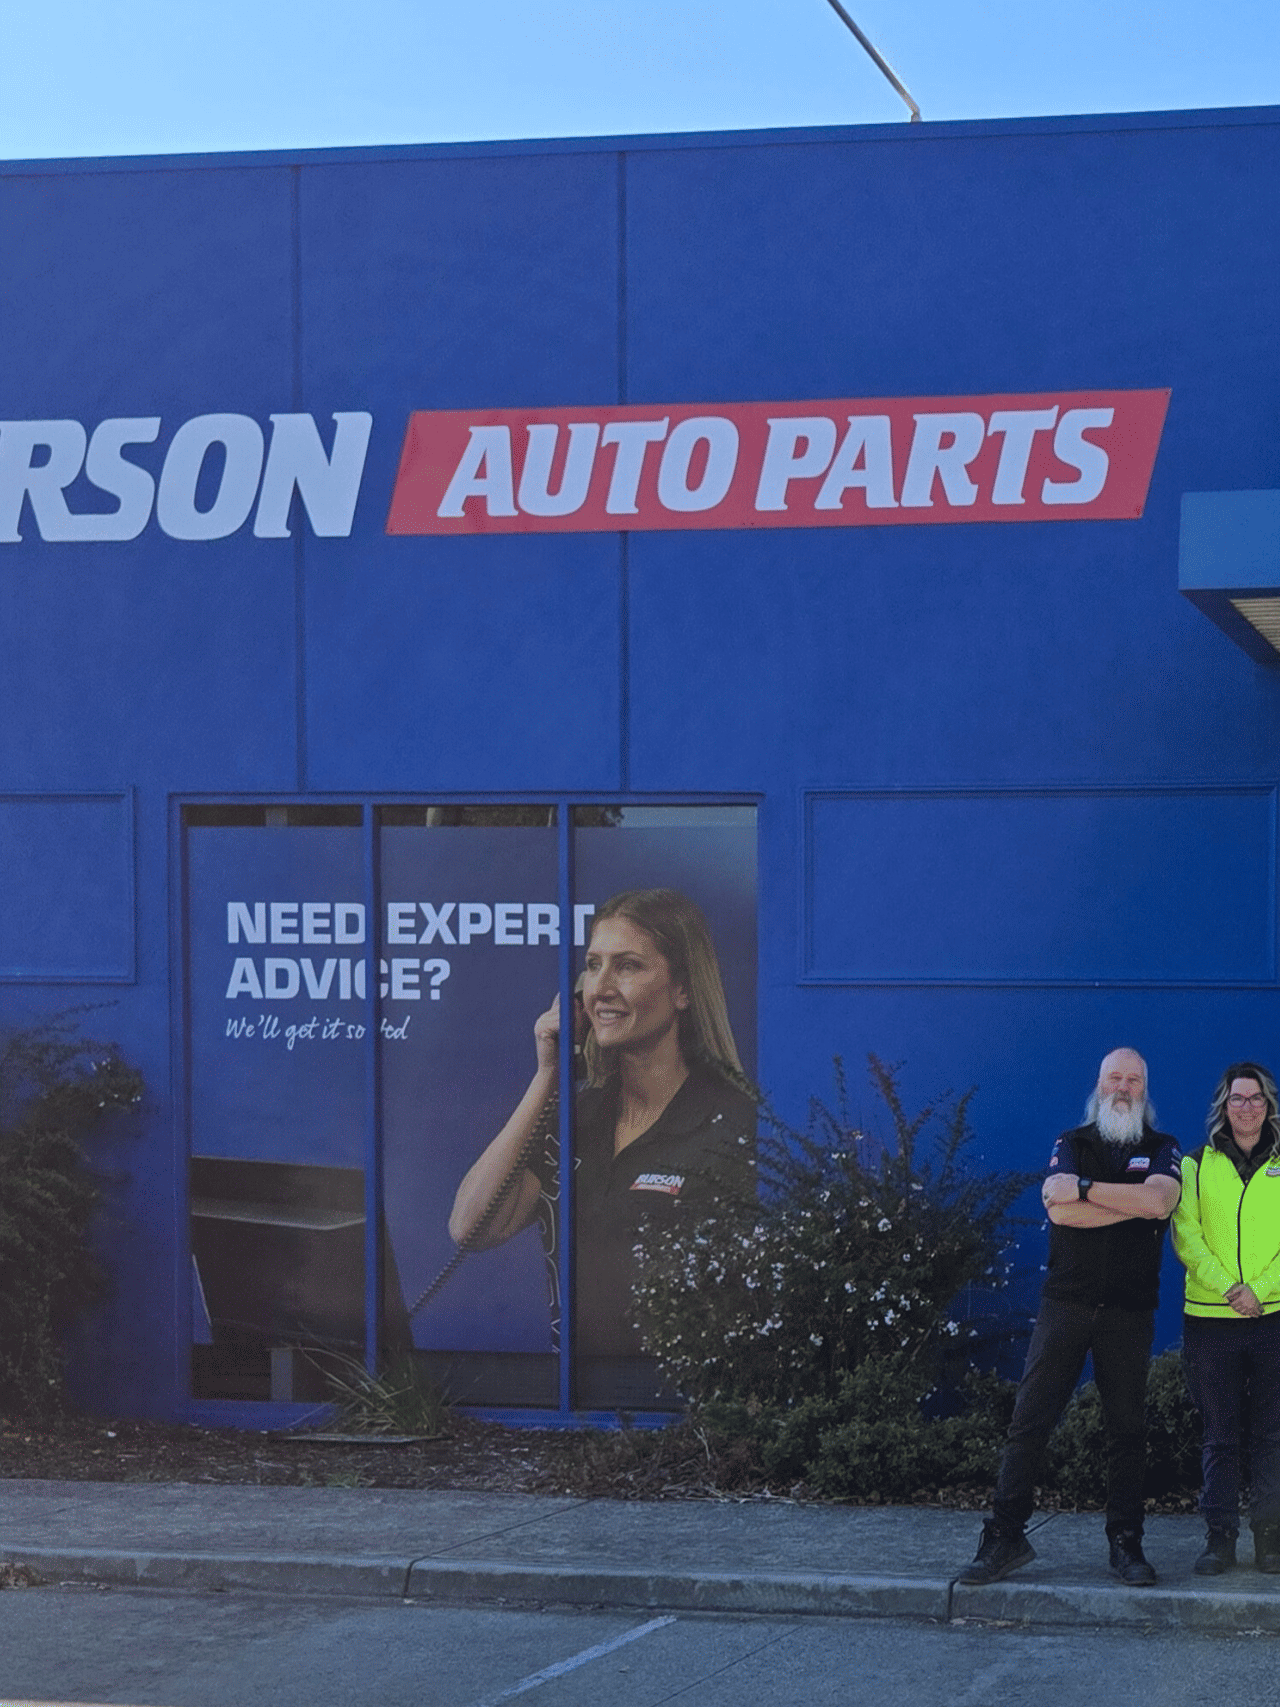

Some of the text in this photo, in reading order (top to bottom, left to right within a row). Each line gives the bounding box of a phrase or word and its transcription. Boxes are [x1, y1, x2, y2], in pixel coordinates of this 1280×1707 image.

[437, 405, 1115, 517] AUTO PARTS
[226, 902, 595, 946] NEED EXPERT
[225, 957, 451, 1000] ADVICE?
[285, 1017, 319, 1050] get
[321, 1017, 346, 1040] it
[346, 1015, 411, 1040] soted
